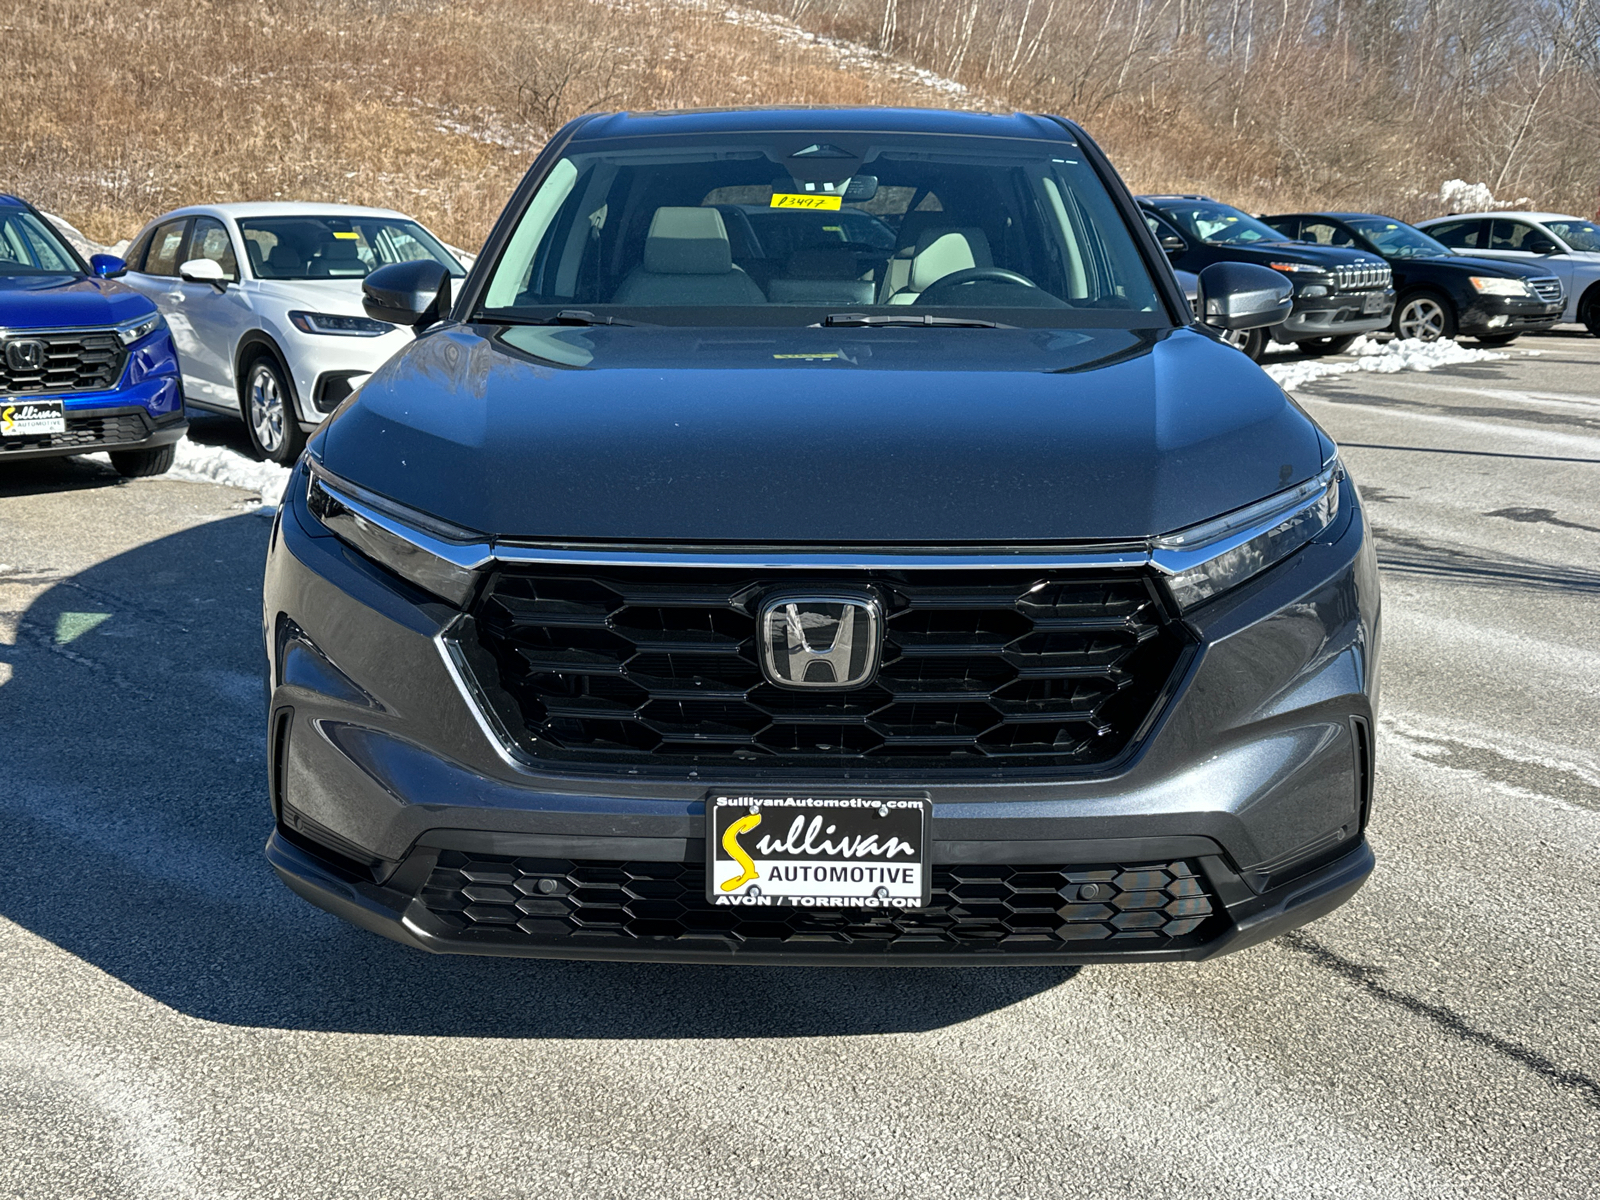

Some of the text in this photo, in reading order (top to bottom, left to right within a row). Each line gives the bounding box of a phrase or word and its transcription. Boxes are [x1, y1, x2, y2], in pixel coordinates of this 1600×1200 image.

[2, 405, 62, 431] Sullivan
[17, 420, 61, 428] AUTOMOTIVE
[716, 796, 923, 809] SullivanAutomotive.com
[720, 813, 915, 892] Sullivan
[768, 866, 914, 884] AUTOMOTIVE
[715, 895, 771, 906] AVON
[788, 895, 921, 908] TORRINGTON
